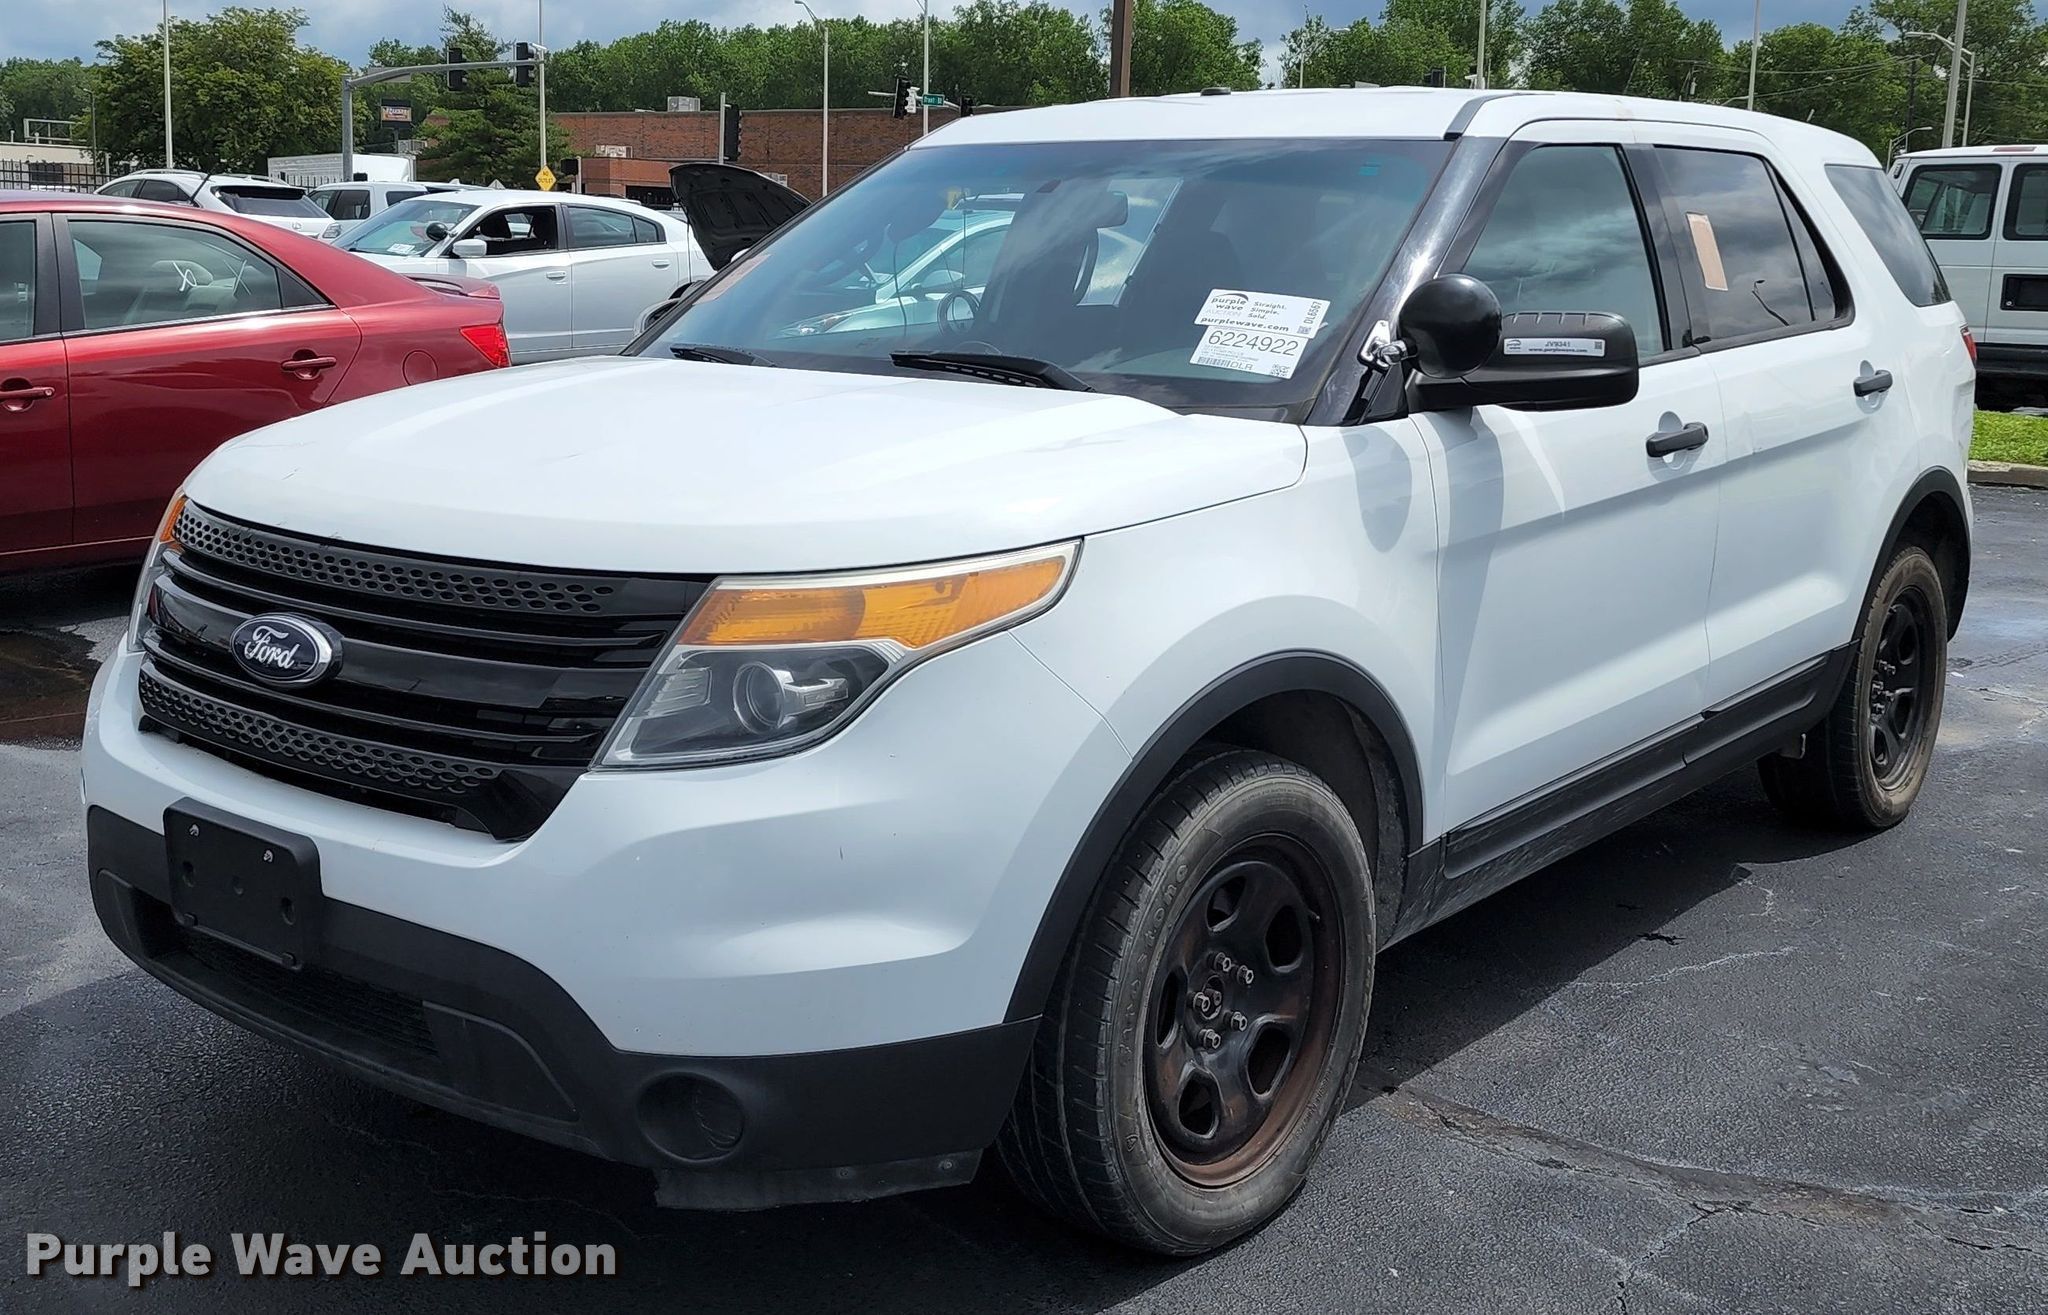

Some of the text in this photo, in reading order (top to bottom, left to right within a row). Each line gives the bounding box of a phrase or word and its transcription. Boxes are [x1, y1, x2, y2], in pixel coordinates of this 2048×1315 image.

[1211, 296, 1247, 306] purple
[1253, 301, 1287, 310] Straight.
[1216, 303, 1243, 311] wave
[1250, 307, 1280, 317] Simple.
[1200, 317, 1290, 332] purplewave.com
[1208, 330, 1299, 356] 6224922
[244, 625, 301, 669] Ford
